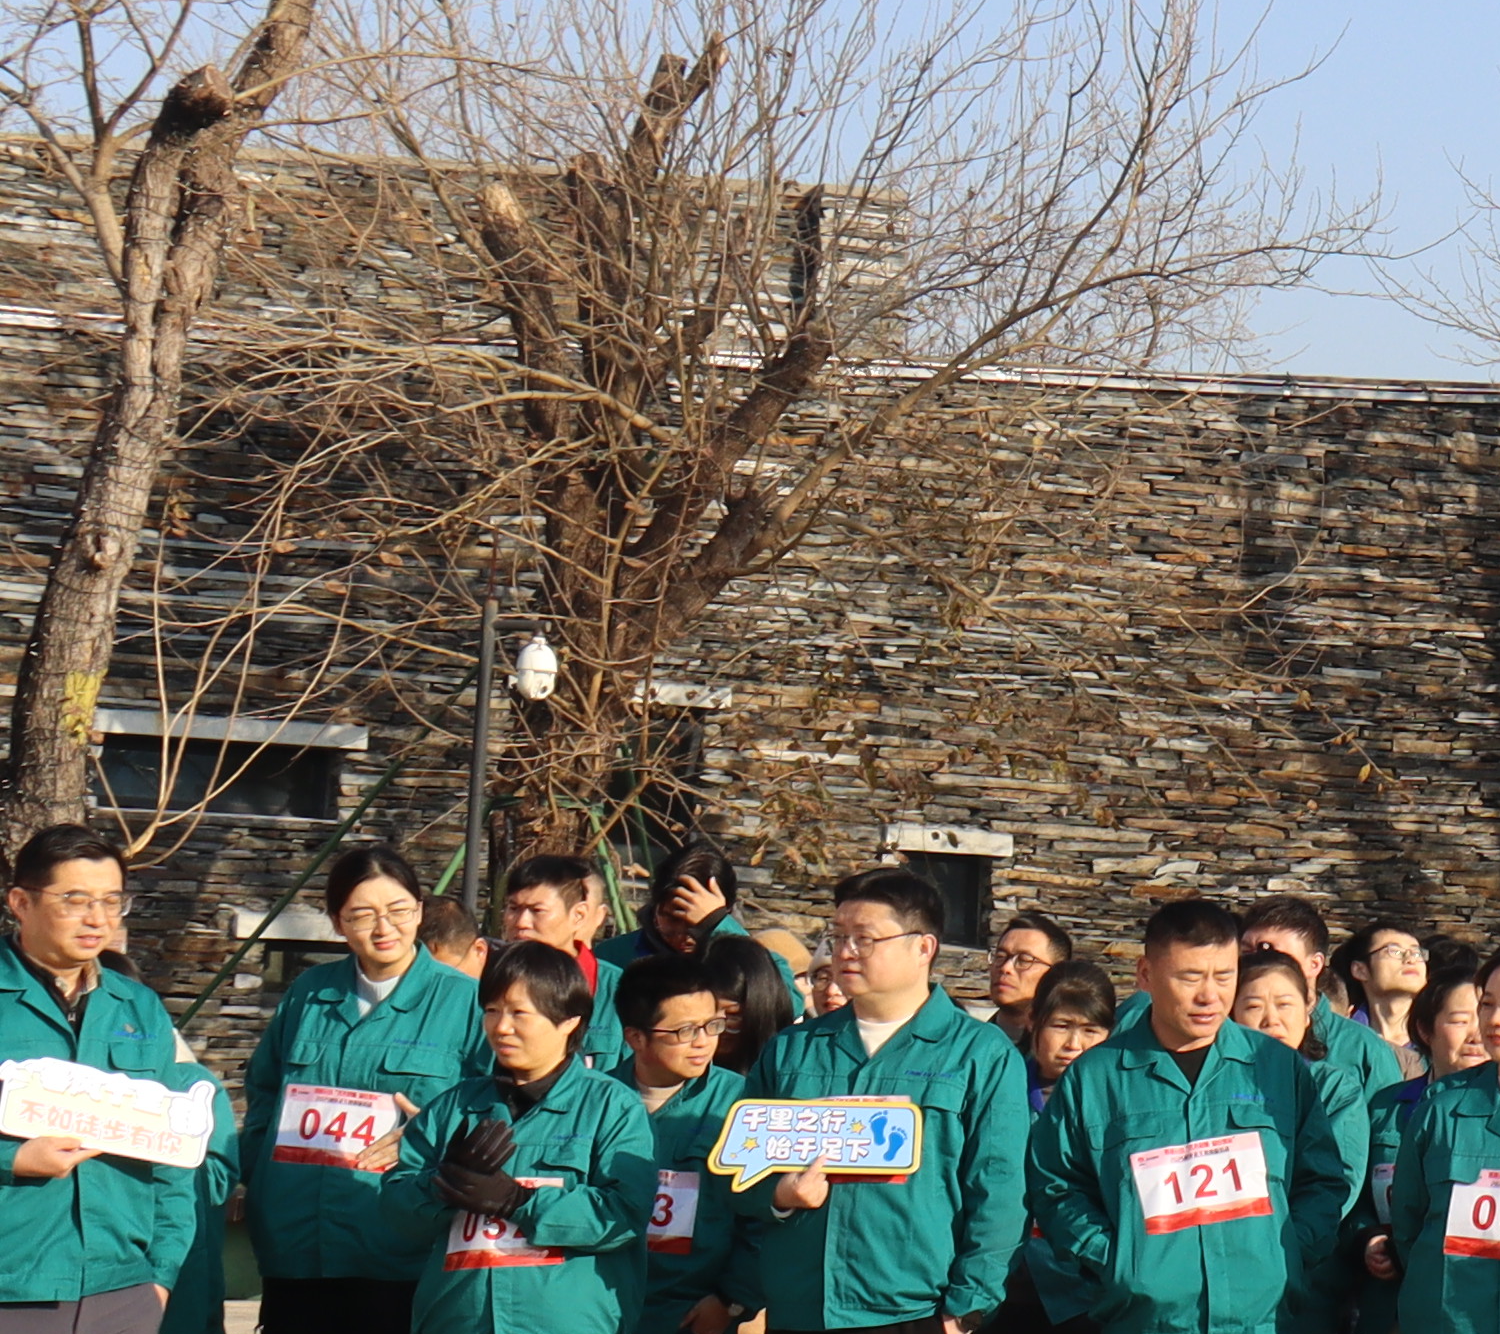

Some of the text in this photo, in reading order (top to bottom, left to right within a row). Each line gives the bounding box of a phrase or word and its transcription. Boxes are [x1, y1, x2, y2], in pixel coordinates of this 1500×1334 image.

[19, 1099, 183, 1155] 不如徒步有你
[299, 1108, 376, 1147] 044
[742, 1107, 847, 1134] 千里之行
[765, 1135, 872, 1163] 始于足下
[1163, 1158, 1243, 1205] 121
